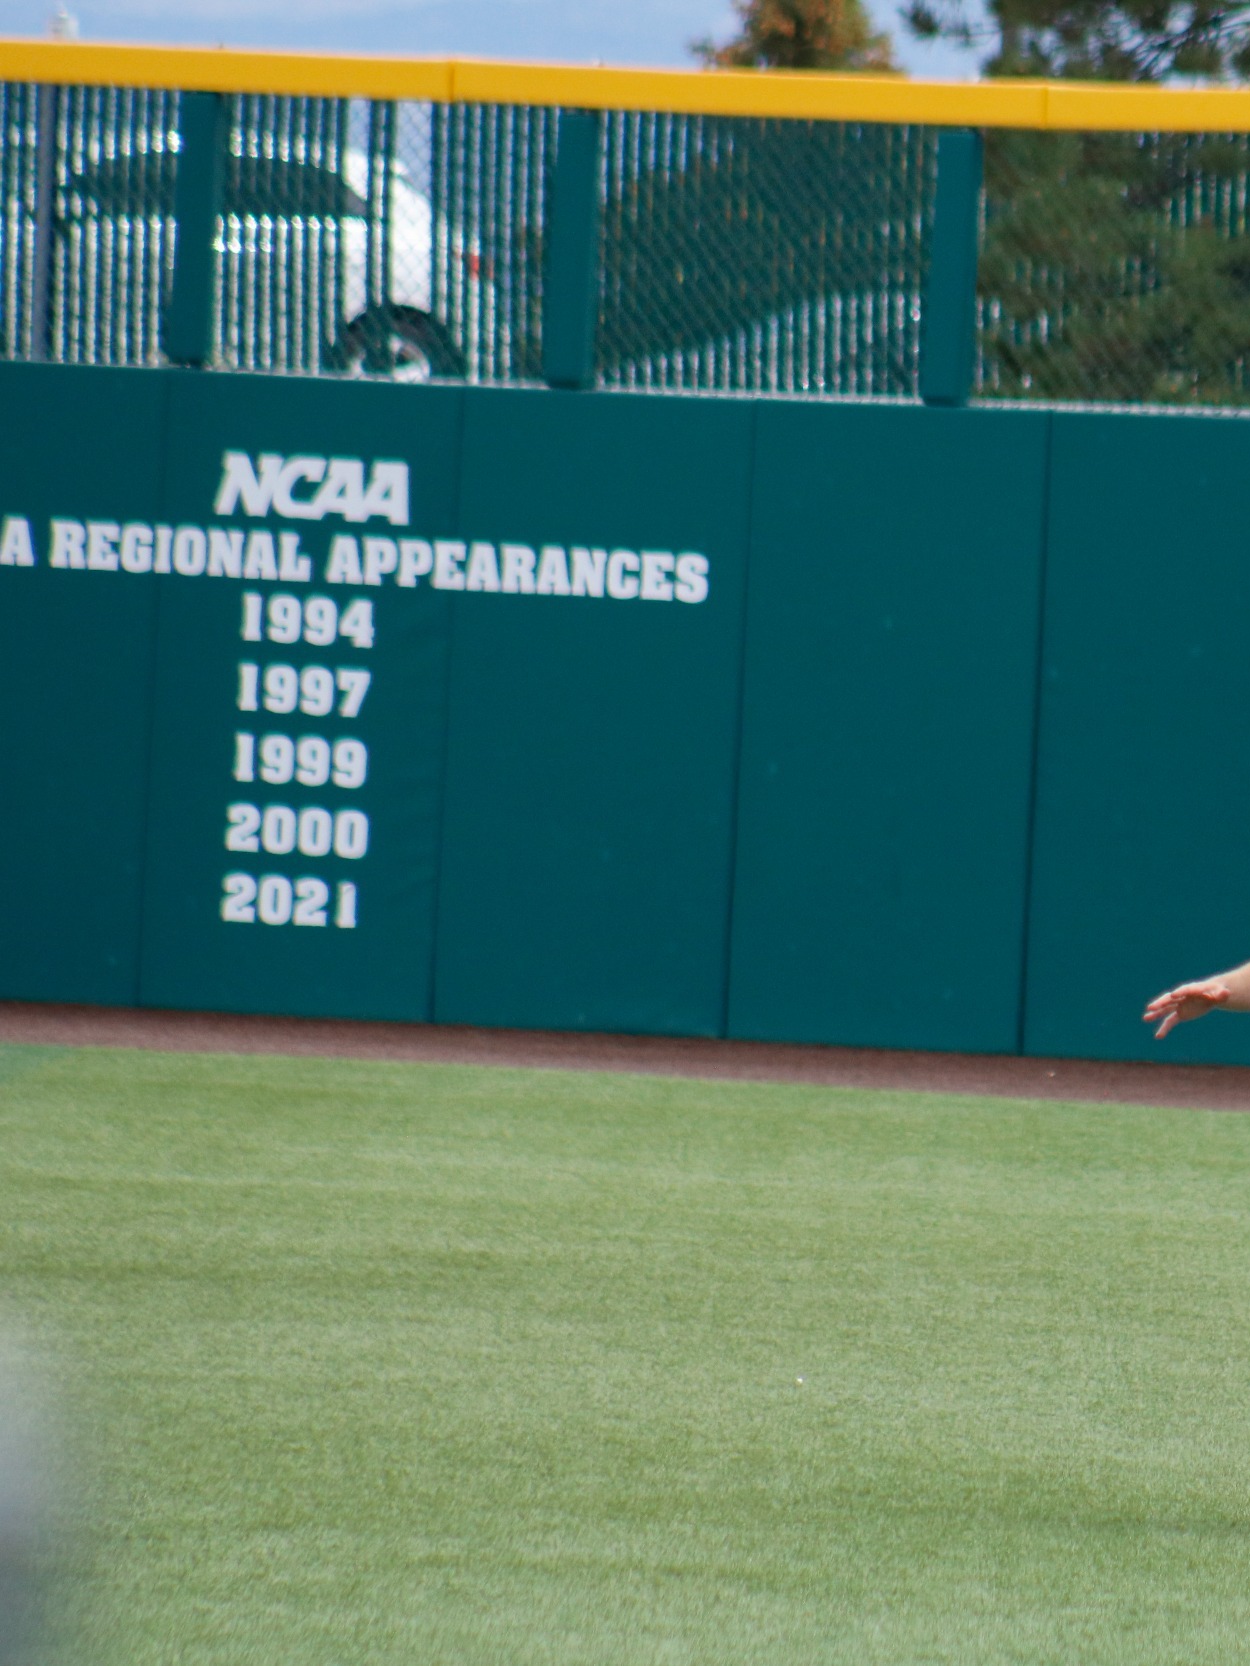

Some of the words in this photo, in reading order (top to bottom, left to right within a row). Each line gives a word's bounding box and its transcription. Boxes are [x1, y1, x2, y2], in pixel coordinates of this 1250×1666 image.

[215, 451, 409, 526] NCAA
[50, 520, 311, 582] REGIONAL
[326, 535, 709, 604] APPEARANCES
[241, 592, 375, 649] 1994
[237, 663, 371, 718] 1997
[233, 733, 368, 789] 1999
[225, 803, 369, 860] 2000
[221, 873, 357, 929] 2021
